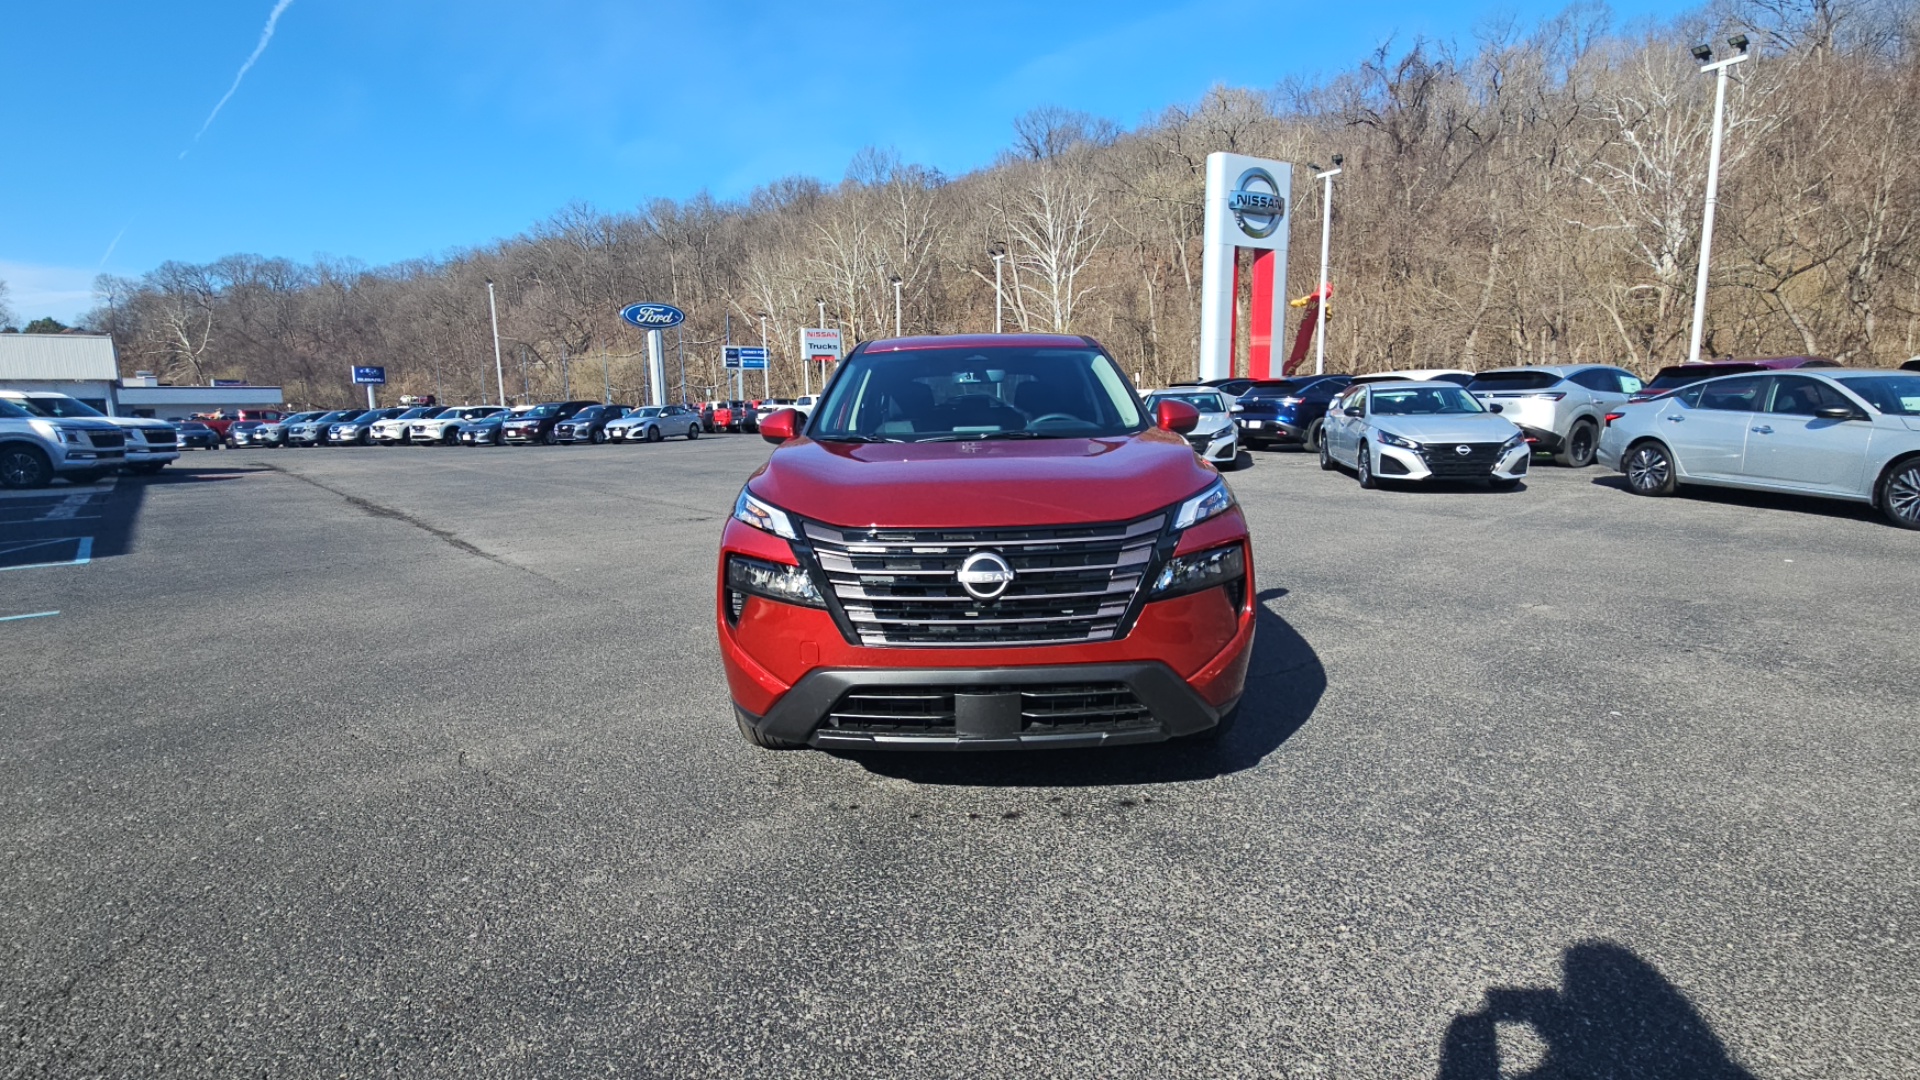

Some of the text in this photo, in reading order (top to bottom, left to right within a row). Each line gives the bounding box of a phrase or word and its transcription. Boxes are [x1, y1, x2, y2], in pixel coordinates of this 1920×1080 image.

[1236, 194, 1282, 210] NISSAN
[637, 306, 674, 323] Ford
[808, 342, 838, 350] Trucks
